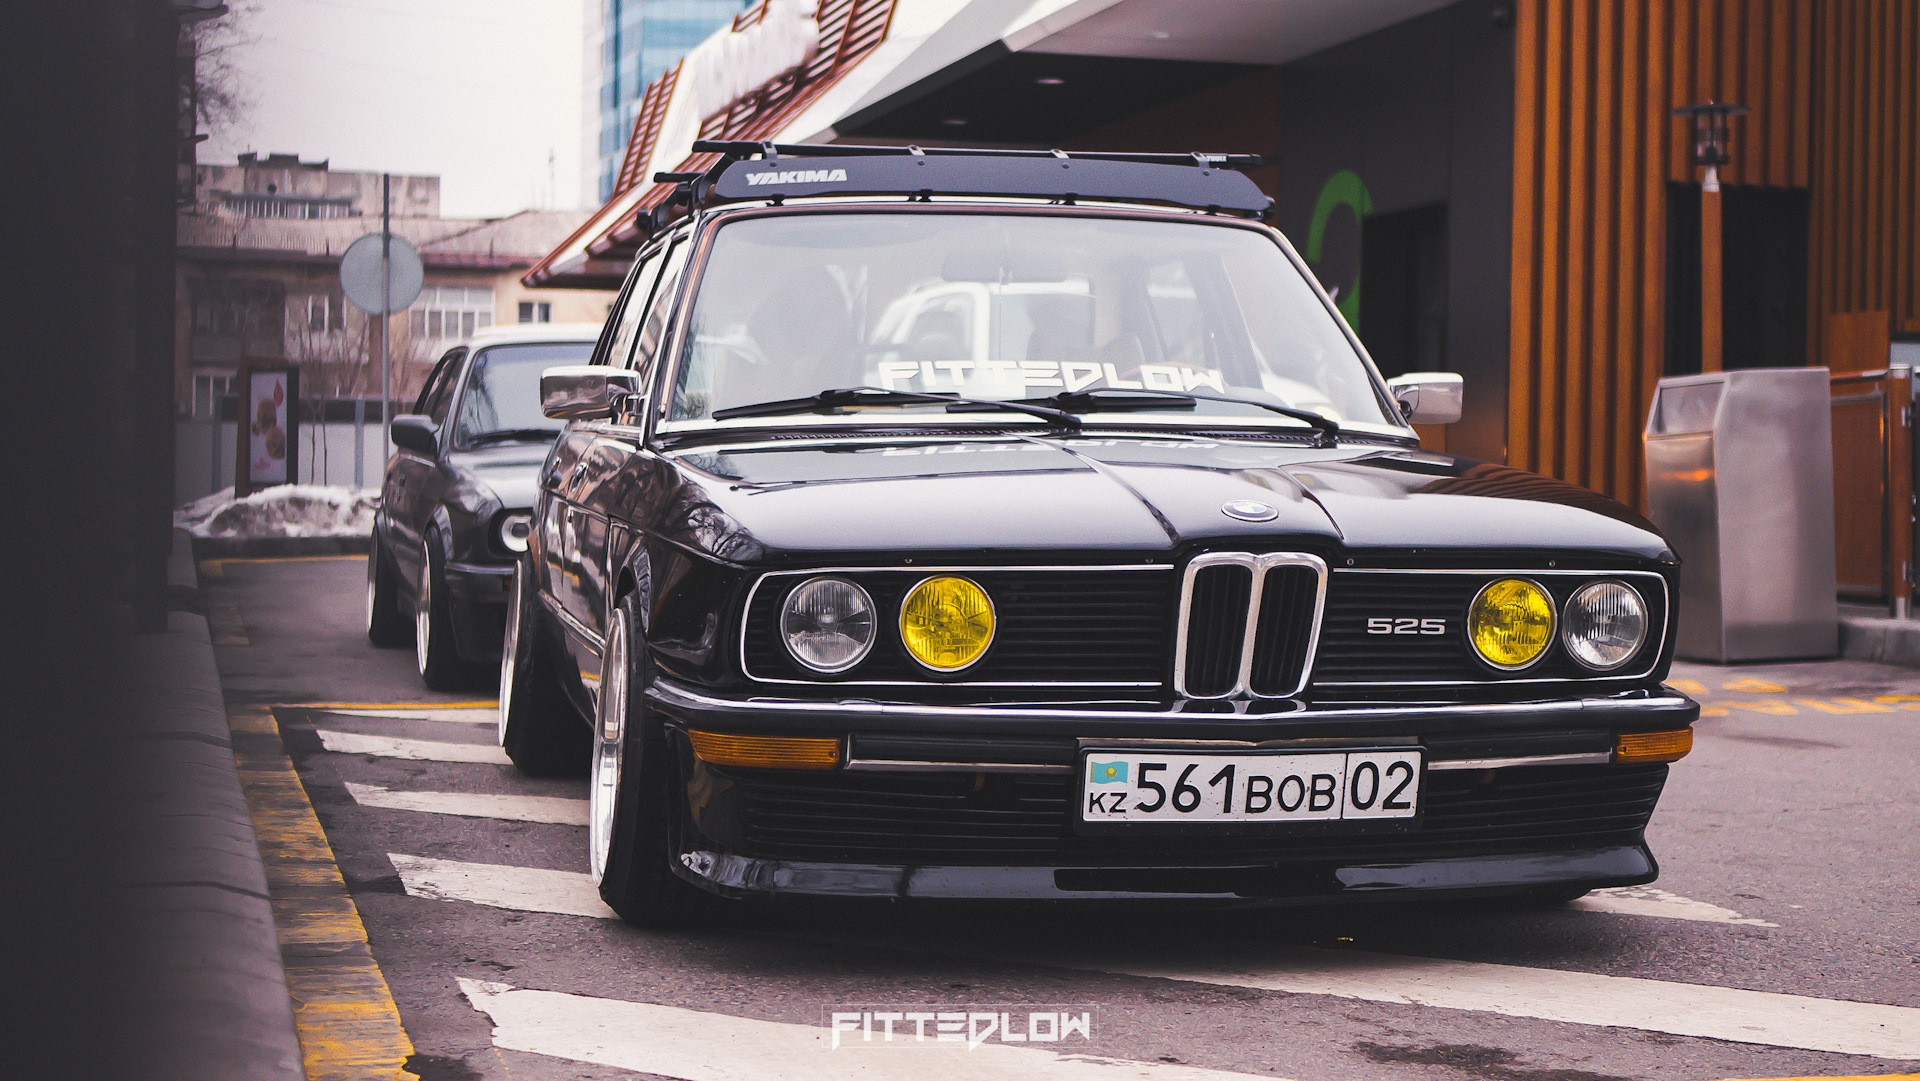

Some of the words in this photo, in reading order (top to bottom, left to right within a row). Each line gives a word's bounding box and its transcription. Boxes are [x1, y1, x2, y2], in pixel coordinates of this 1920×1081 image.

[746, 169, 847, 185] YAKIMA
[878, 360, 1225, 395] FITTEDLOW
[1367, 618, 1446, 635] 525
[1088, 792, 1127, 813] KZ
